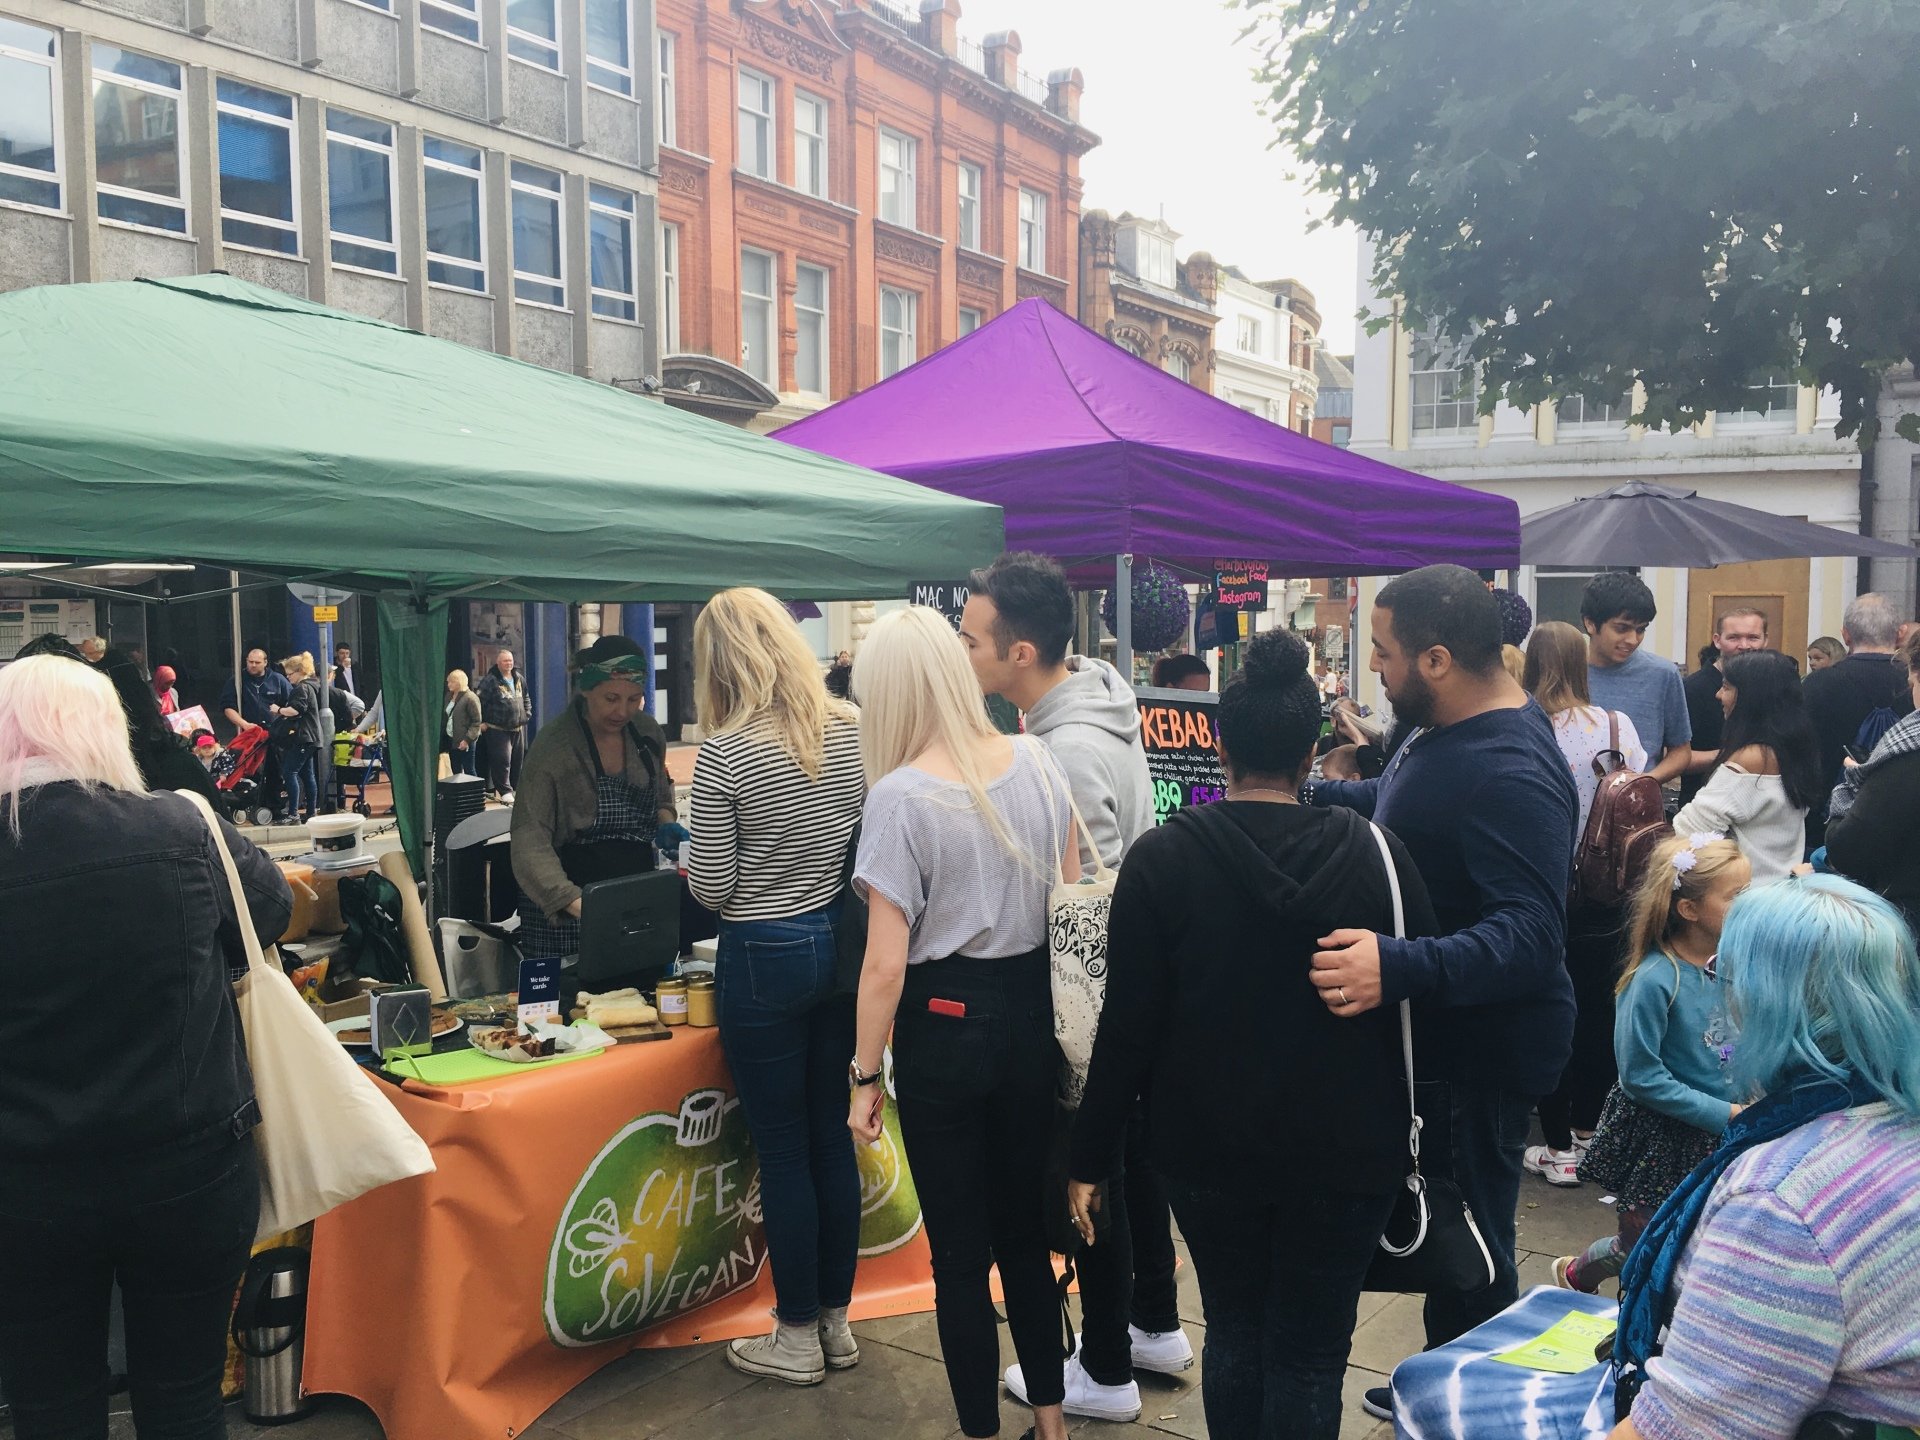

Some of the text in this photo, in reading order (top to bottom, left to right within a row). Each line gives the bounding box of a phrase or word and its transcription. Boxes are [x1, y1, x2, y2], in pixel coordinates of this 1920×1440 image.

[1249, 570, 1267, 582] Food
[916, 585, 944, 609] MAC
[1218, 587, 1261, 609] Instagram
[633, 1158, 739, 1231] CAFE
